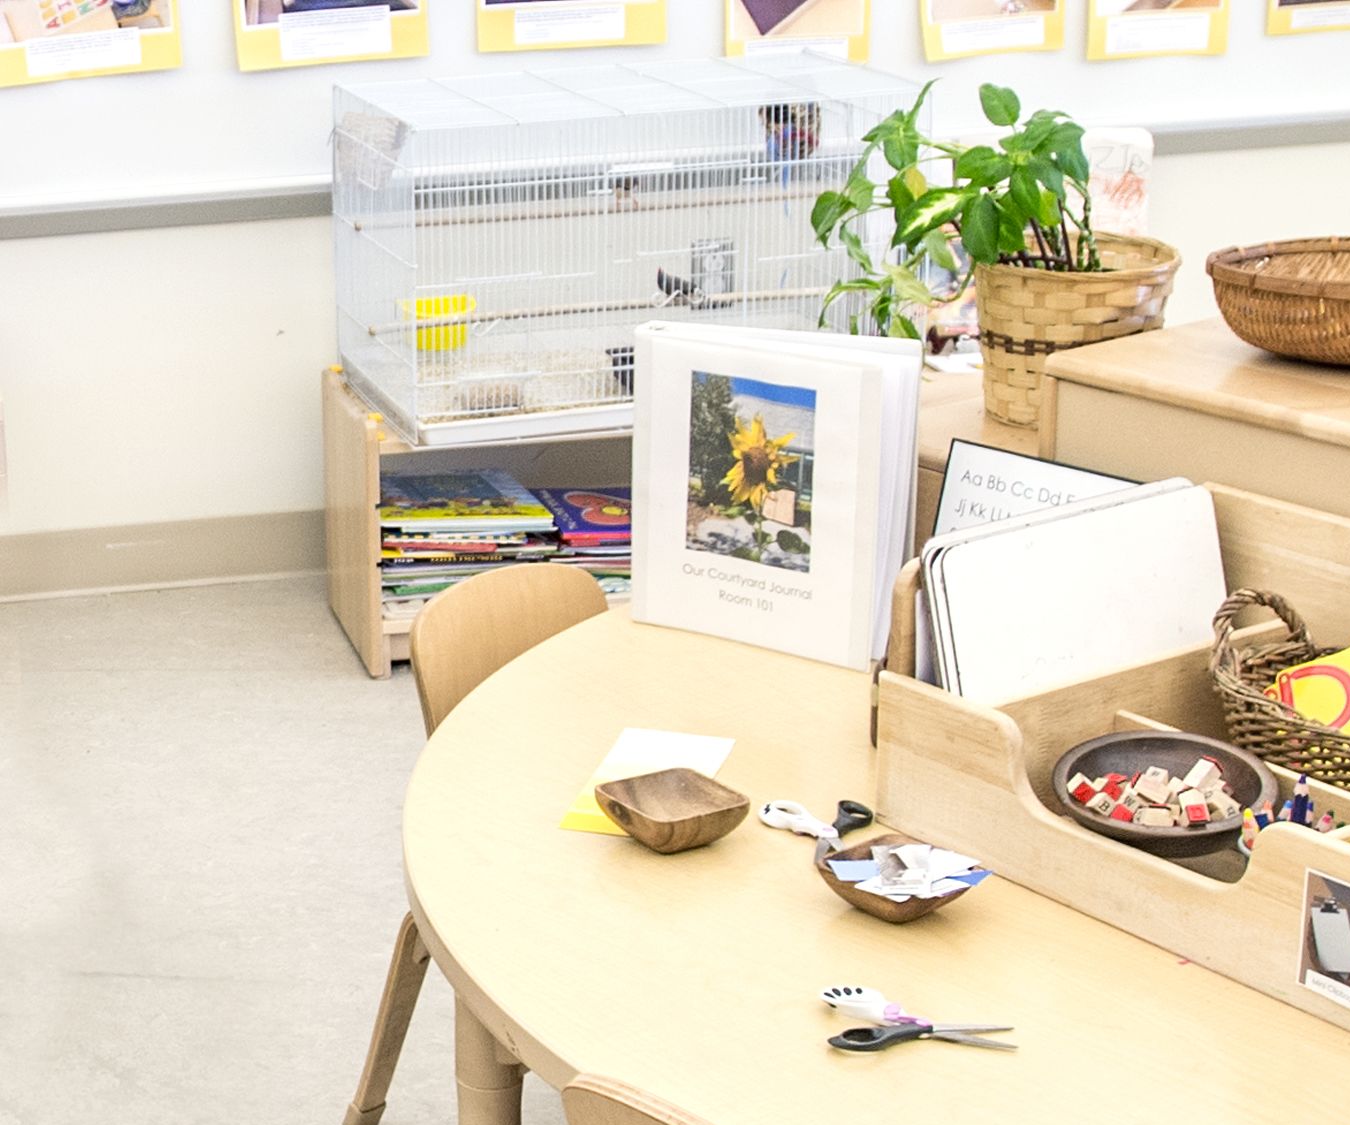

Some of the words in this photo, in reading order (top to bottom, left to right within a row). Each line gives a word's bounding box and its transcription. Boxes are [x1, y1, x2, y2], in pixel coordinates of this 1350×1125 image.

[961, 469, 983, 487] Aa
[987, 474, 1007, 493] Bb
[1010, 480, 1034, 499] Cc
[1038, 487, 1062, 507] Dd
[955, 498, 967, 517] Jj
[970, 502, 987, 519] Kk
[682, 562, 704, 577] Our
[707, 567, 766, 591] Courtyard
[768, 581, 813, 600] Journal
[718, 589, 752, 607] Room
[756, 597, 774, 612] 101
